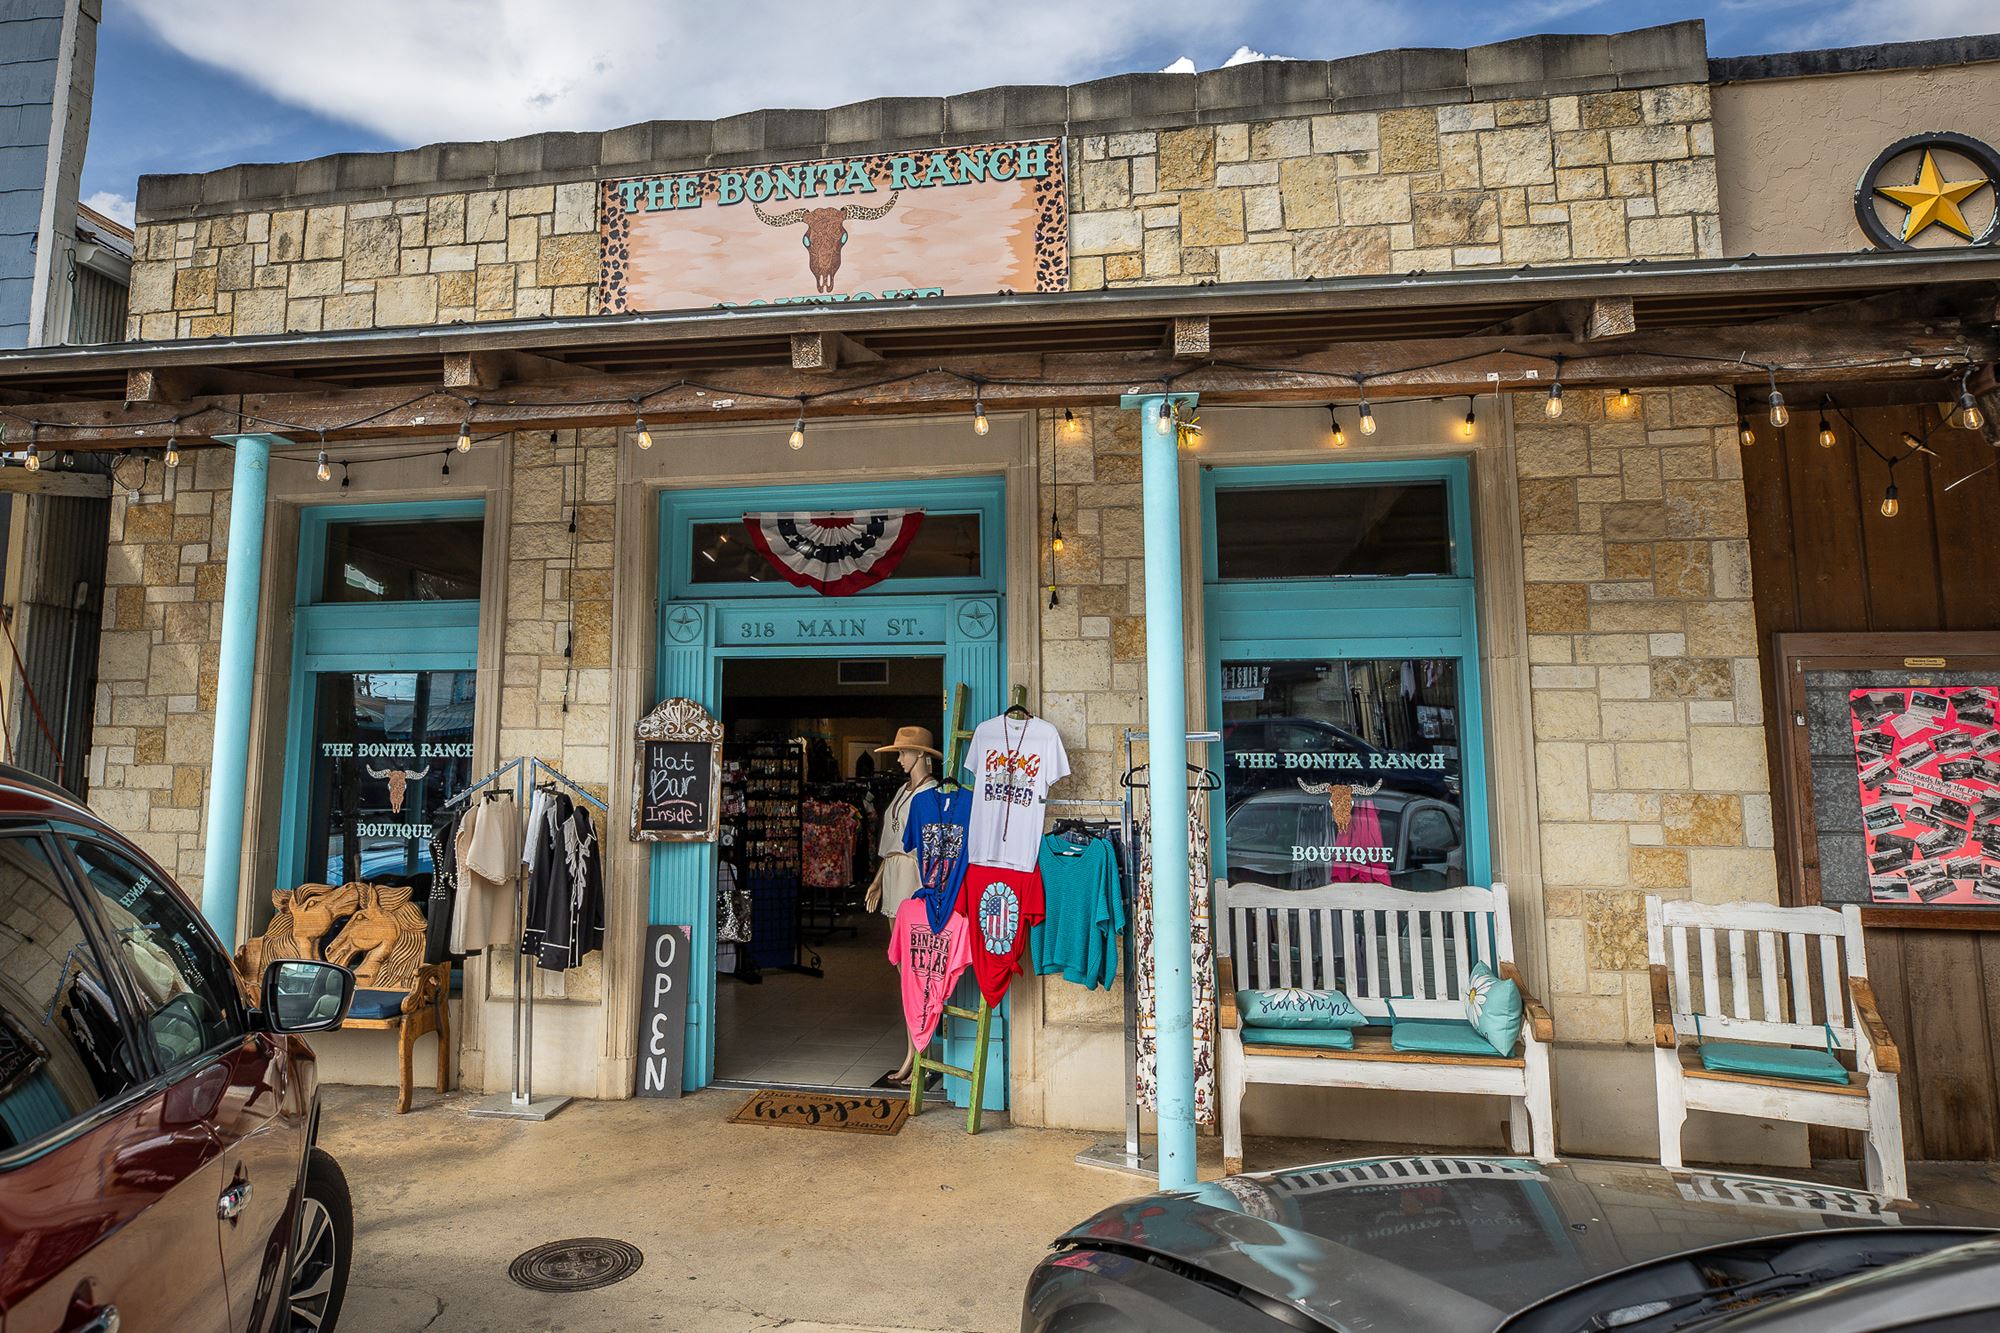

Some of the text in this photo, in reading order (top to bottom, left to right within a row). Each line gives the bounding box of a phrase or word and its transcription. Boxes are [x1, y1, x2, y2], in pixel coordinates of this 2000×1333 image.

[617, 144, 1051, 214] THE BONITA RANCH
[741, 618, 925, 639] 318 MAIN ST.
[322, 743, 474, 757] THE BONITA RANCH
[653, 746, 695, 771] Hat
[1235, 753, 1446, 770] THE BONITA RANCH
[648, 769, 697, 805] Bar
[356, 823, 433, 839] BOUTIQUE
[1292, 845, 1394, 864] BOUTIQUE
[644, 933, 676, 1092] OPEN
[1259, 998, 1355, 1016] sunshine
[755, 1098, 896, 1124] happy
